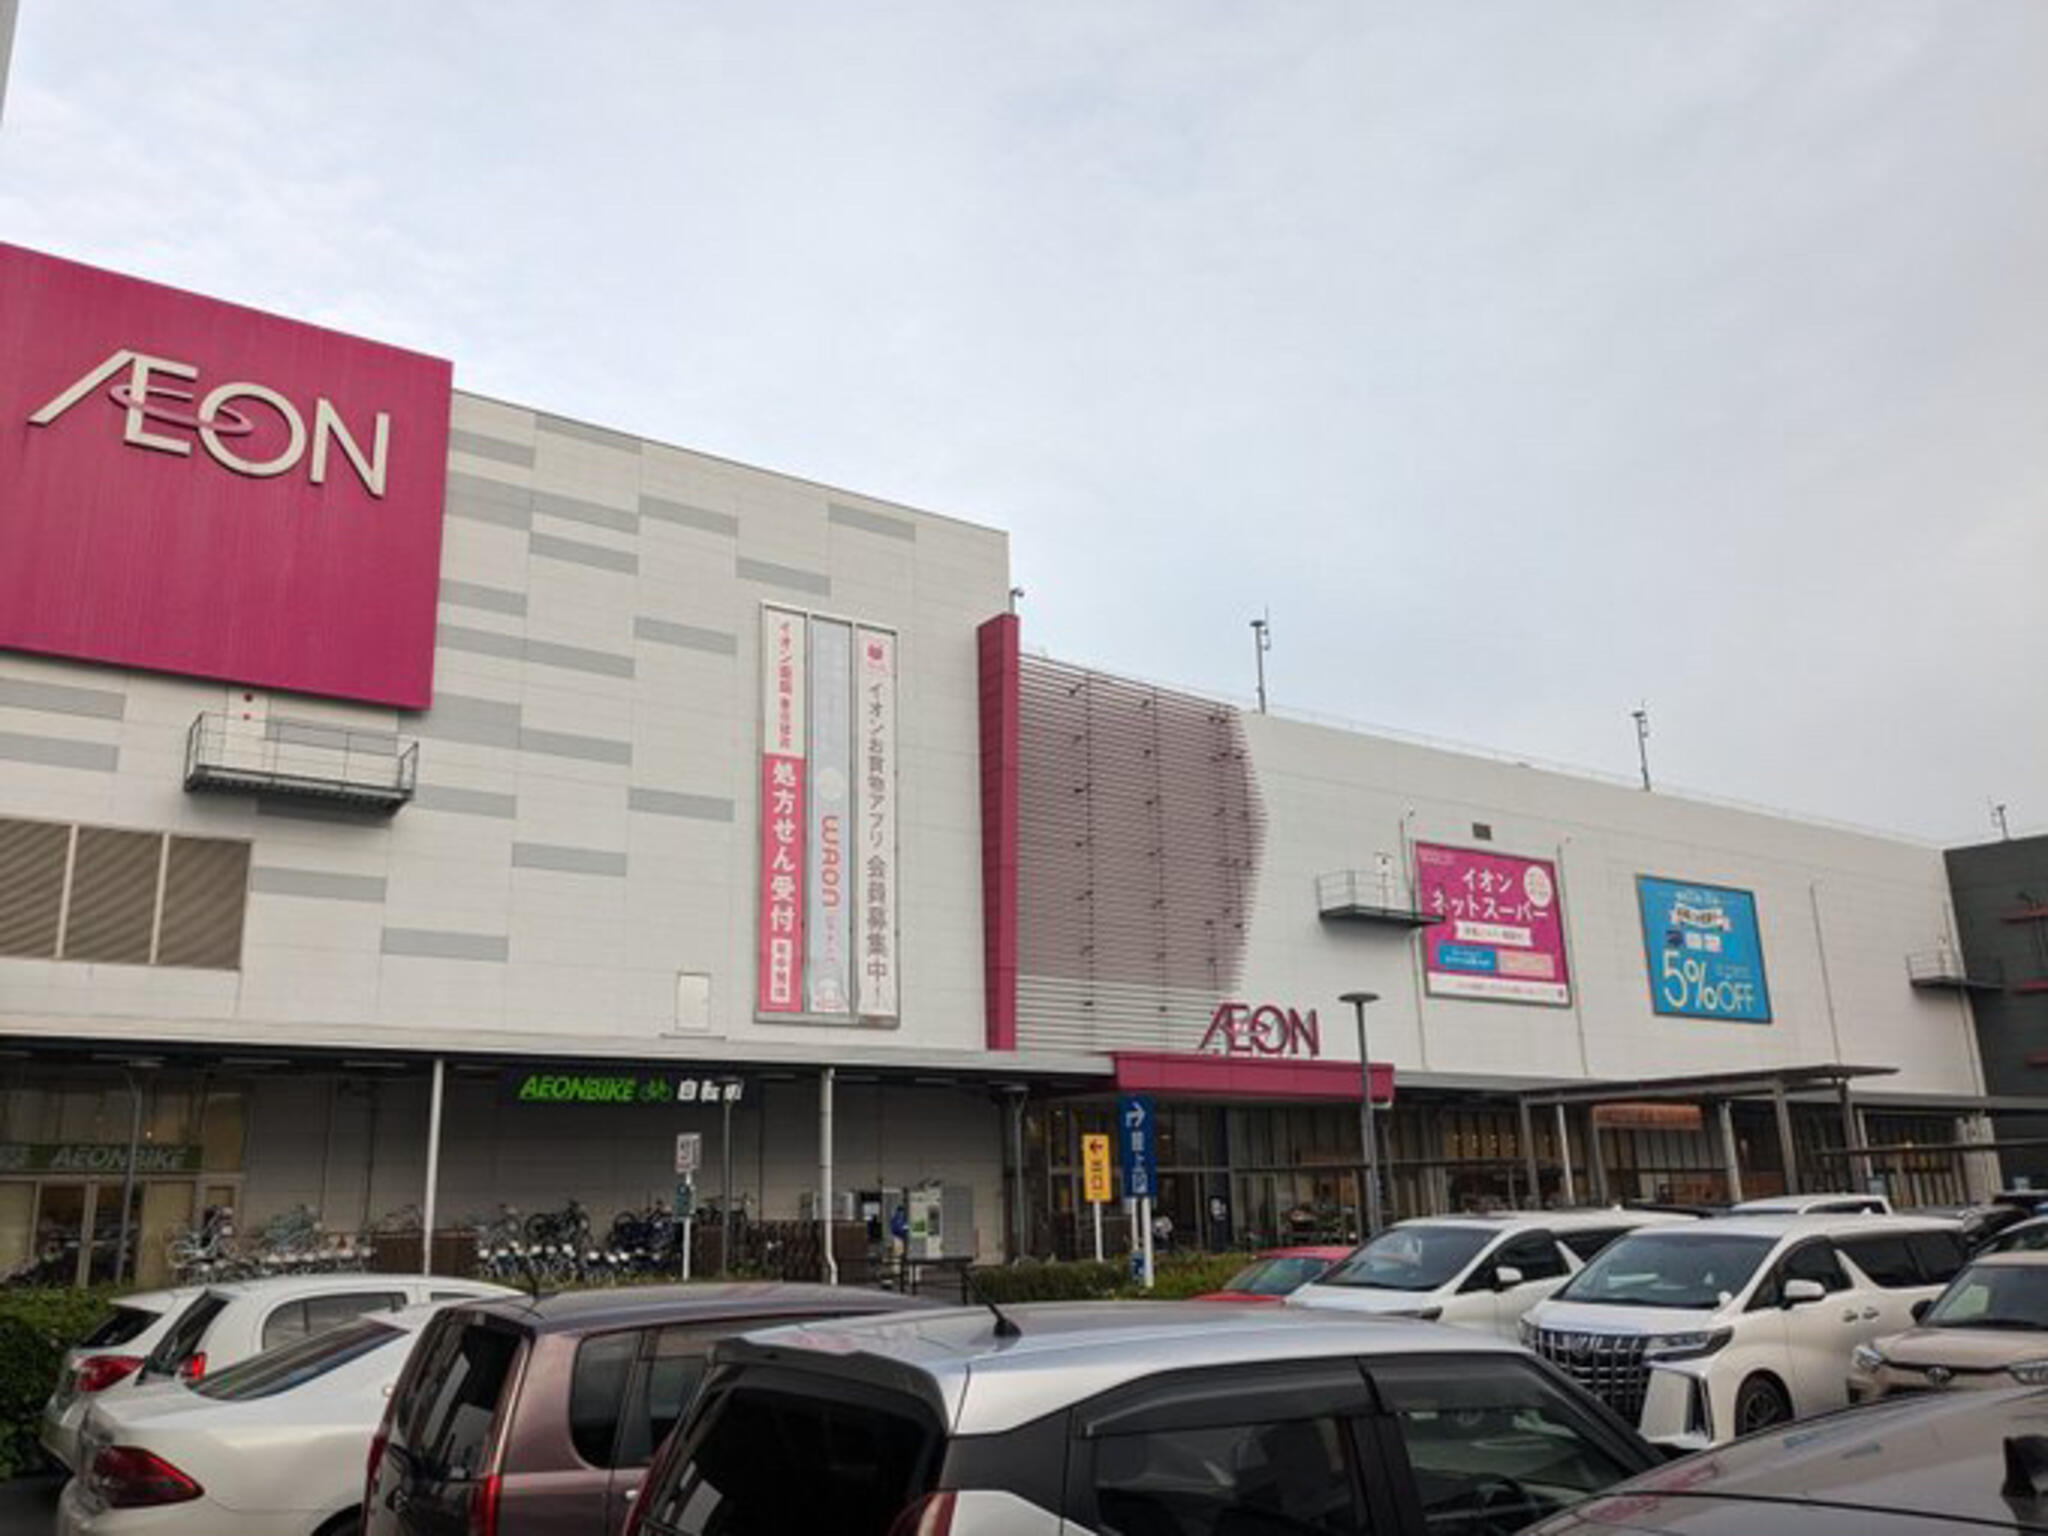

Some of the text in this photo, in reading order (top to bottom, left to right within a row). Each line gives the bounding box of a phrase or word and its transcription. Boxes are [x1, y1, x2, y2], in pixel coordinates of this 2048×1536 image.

[771, 760, 796, 932] 処方せん受付
[1463, 867, 1514, 893] イオン
[1432, 888, 1549, 922] ネットスーパー
